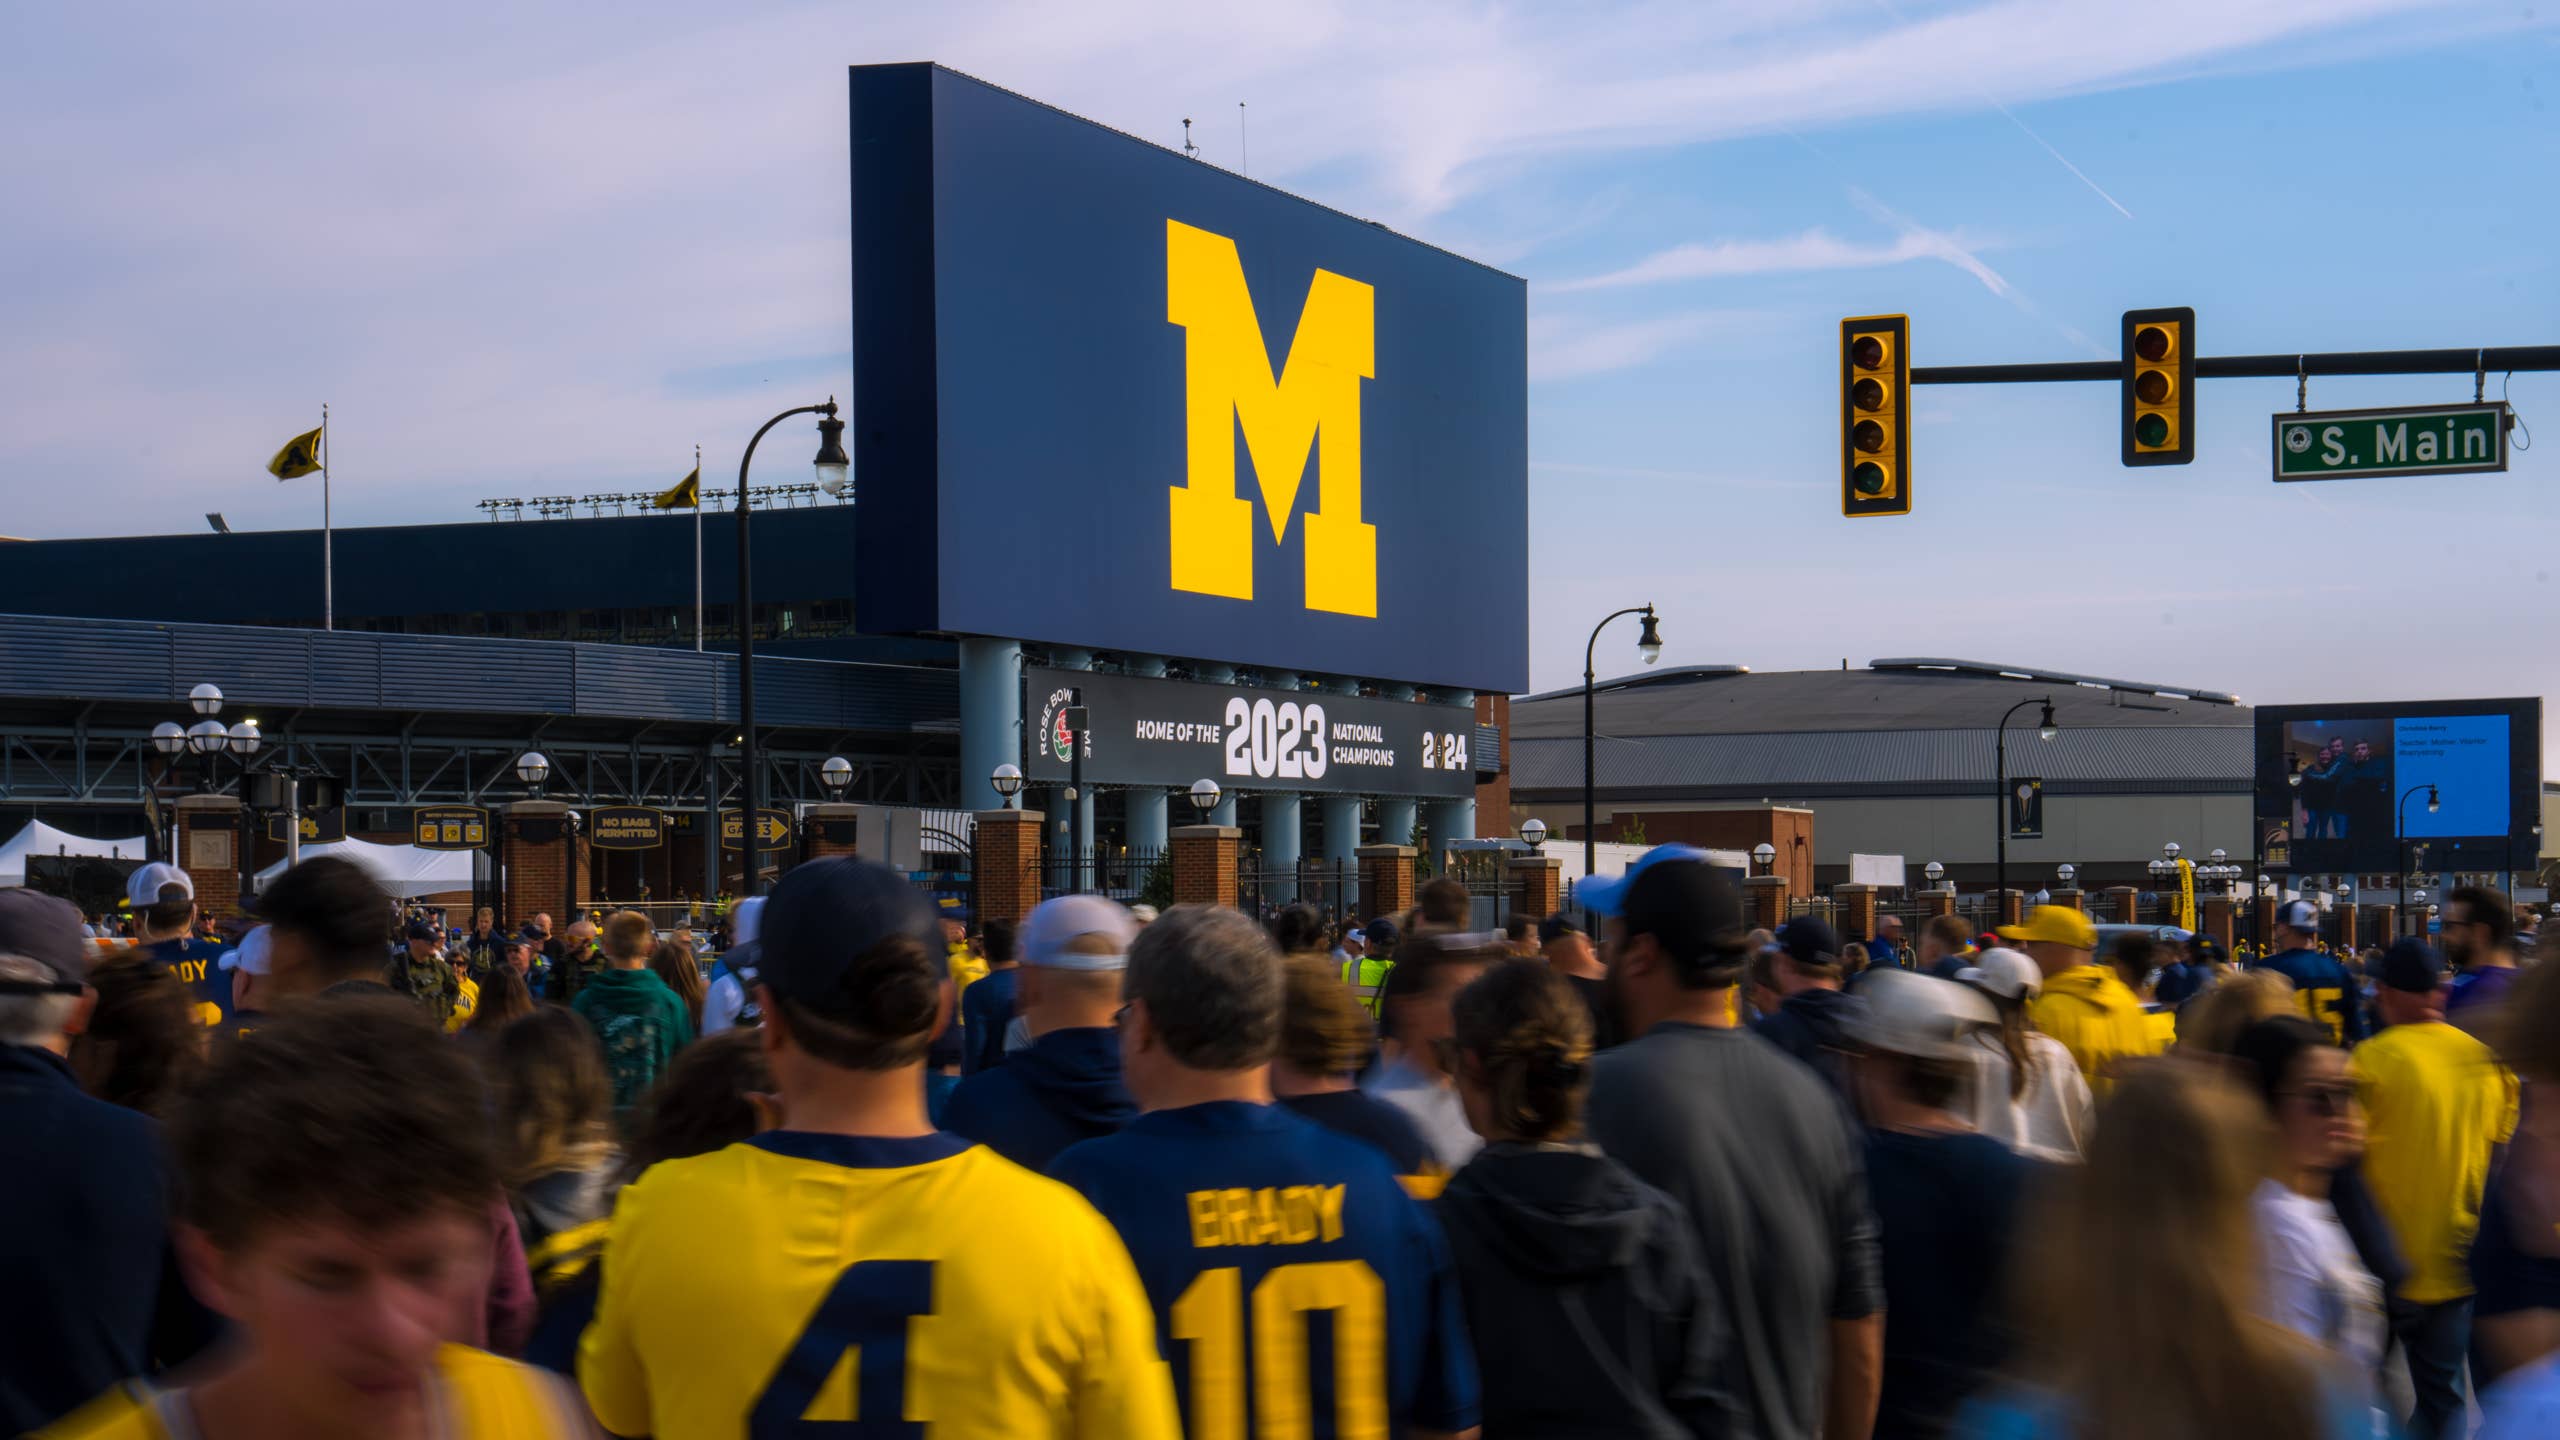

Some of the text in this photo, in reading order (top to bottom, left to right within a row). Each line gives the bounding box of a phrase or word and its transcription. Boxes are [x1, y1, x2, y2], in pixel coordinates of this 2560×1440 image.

[1166, 218, 1377, 619] M
[2320, 425, 2359, 467] S.
[2375, 419, 2487, 464] Main
[1039, 703, 1053, 756] ROSE
[1050, 687, 1073, 708] BOW
[1135, 696, 1327, 779] HOME OF THE 2023
[1332, 722, 1384, 743] NATIONAL
[1332, 746, 1395, 767] CHAMPIONS
[299, 817, 320, 838] 4
[595, 828, 658, 838] PERMITTED
[602, 817, 651, 828] NO BAGS
[763, 824, 772, 835] 3
[1186, 1183, 1347, 1248] BRADY
[743, 1259, 941, 1440] 4
[1171, 1259, 1390, 1440] 10
